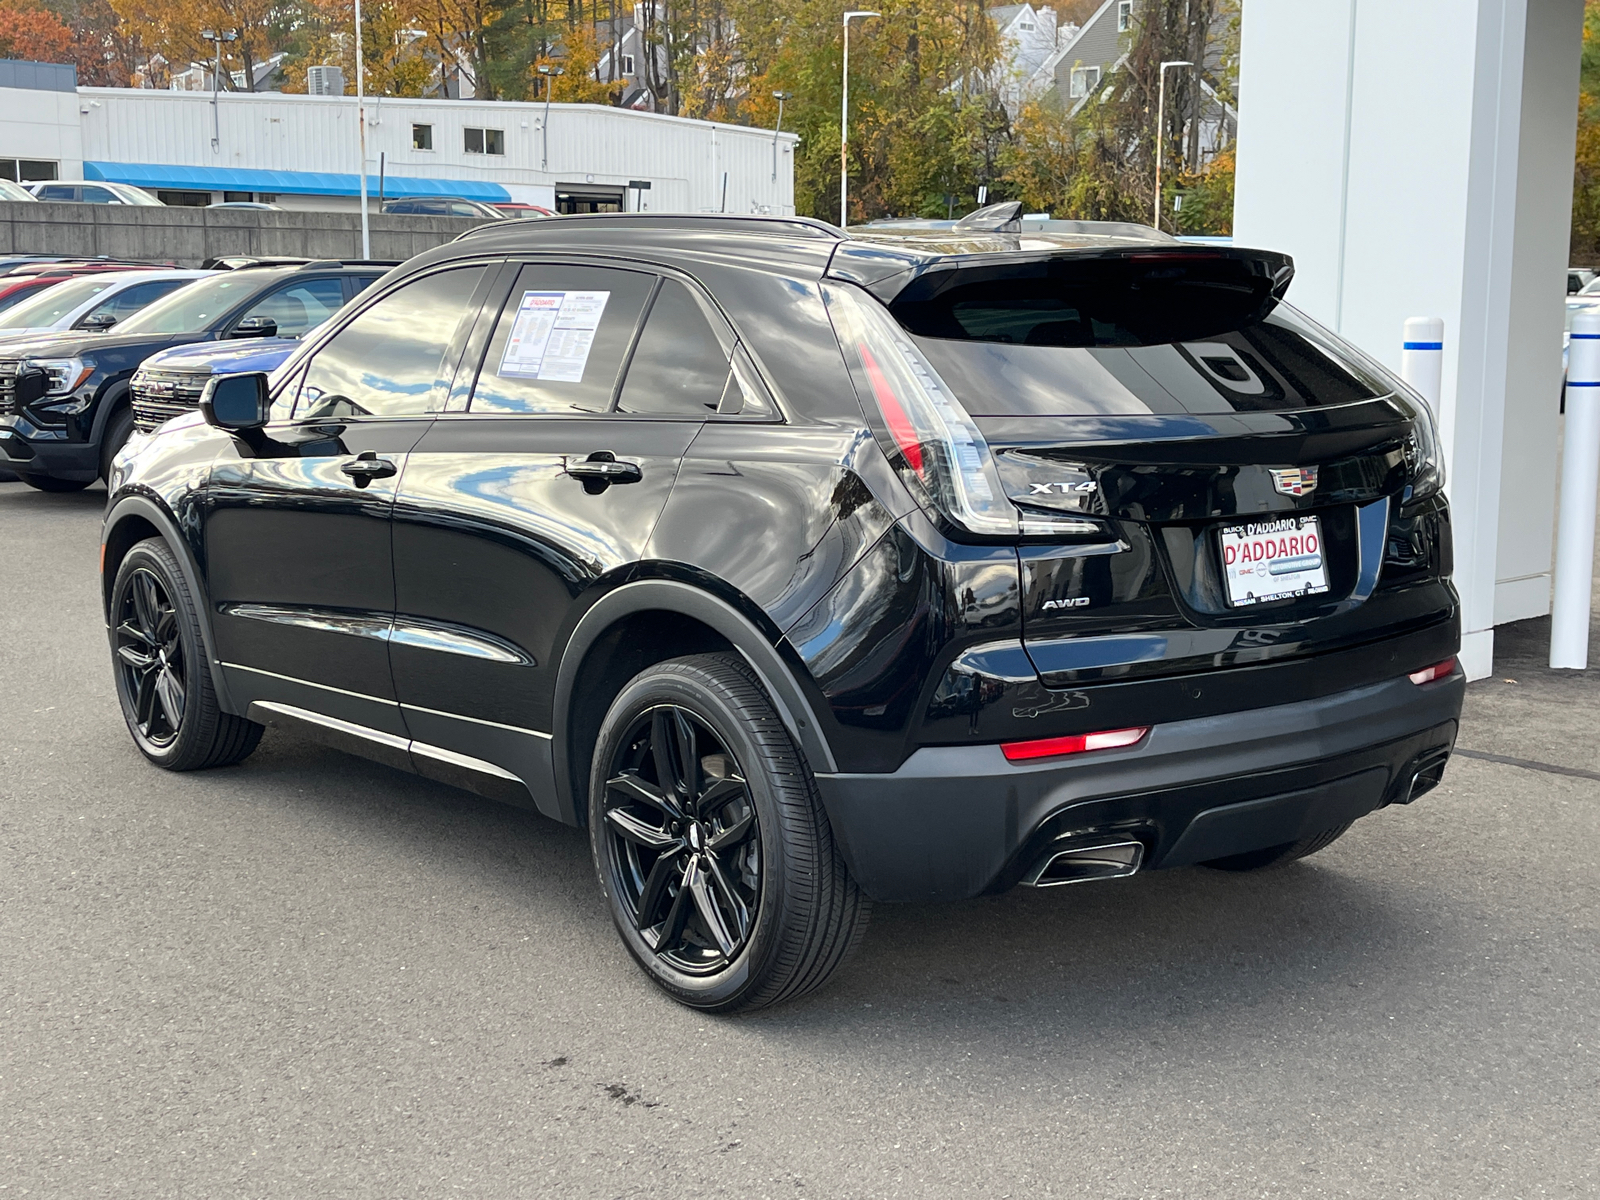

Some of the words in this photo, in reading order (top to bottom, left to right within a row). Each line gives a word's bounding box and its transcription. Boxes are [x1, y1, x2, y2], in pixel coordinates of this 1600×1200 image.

[1028, 481, 1097, 495] XT4
[1223, 525, 1244, 534] BUICK
[1247, 518, 1296, 535] D'ADDARIO
[1299, 515, 1317, 523] GMC
[1225, 533, 1318, 565] D'ADDARIO
[1042, 596, 1091, 610] AWD
[1260, 591, 1294, 602] SHELTON,
